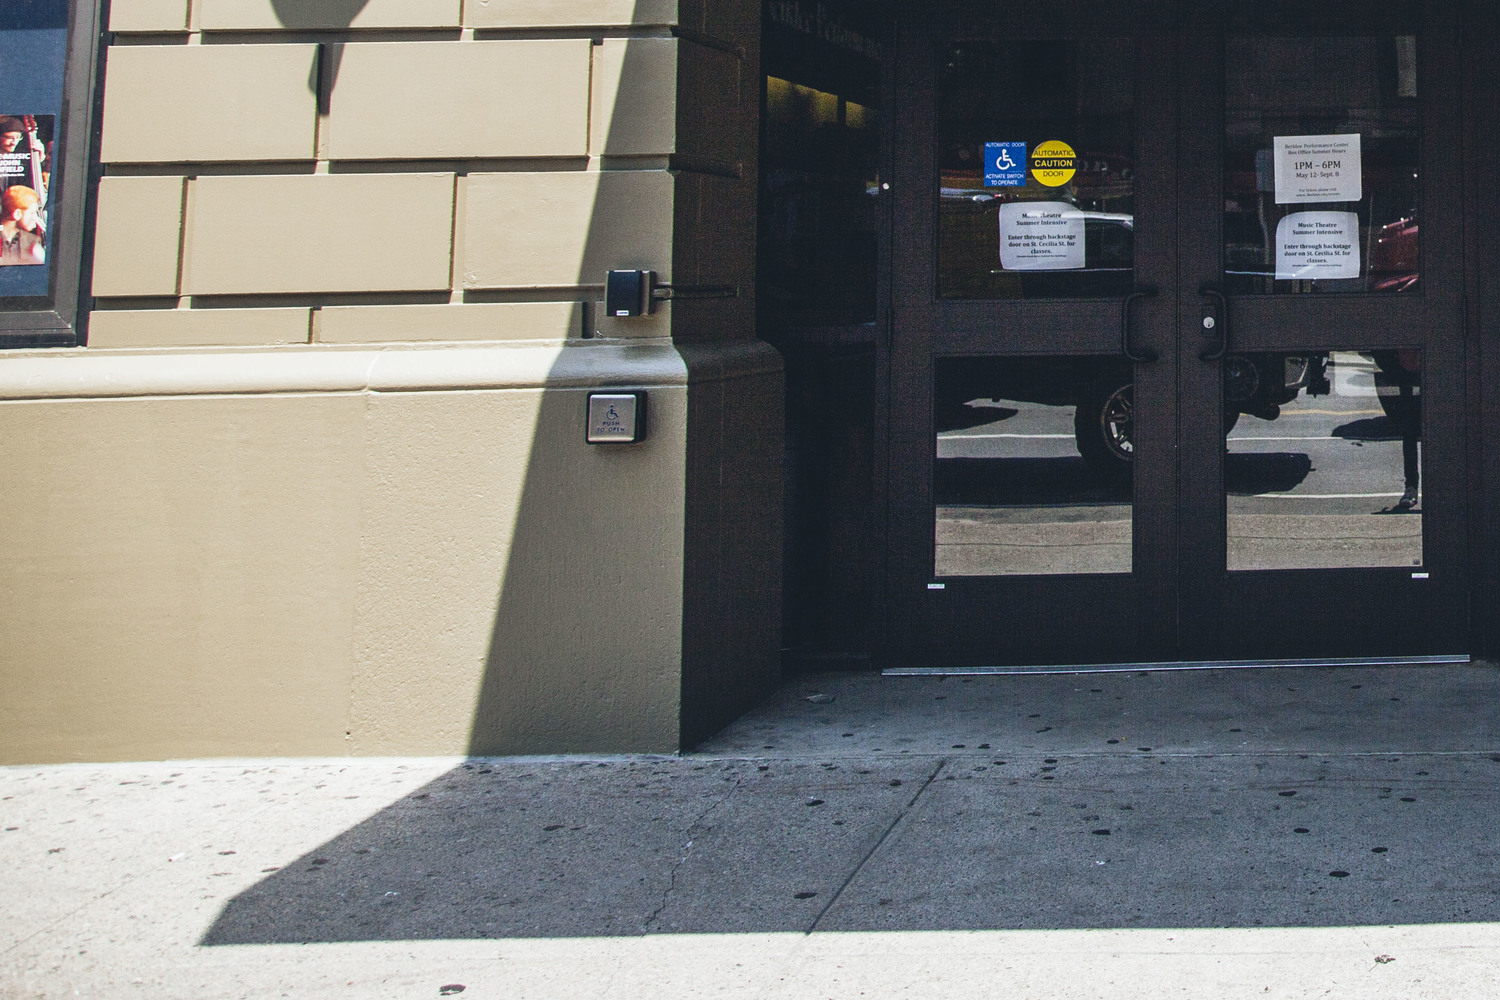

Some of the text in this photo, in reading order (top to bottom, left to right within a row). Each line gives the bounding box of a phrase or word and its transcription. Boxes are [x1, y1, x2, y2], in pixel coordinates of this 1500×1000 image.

[1034, 159, 1073, 167] CAUTION
[1295, 161, 1313, 170] 1PM
[1322, 160, 1341, 169] 6PM
